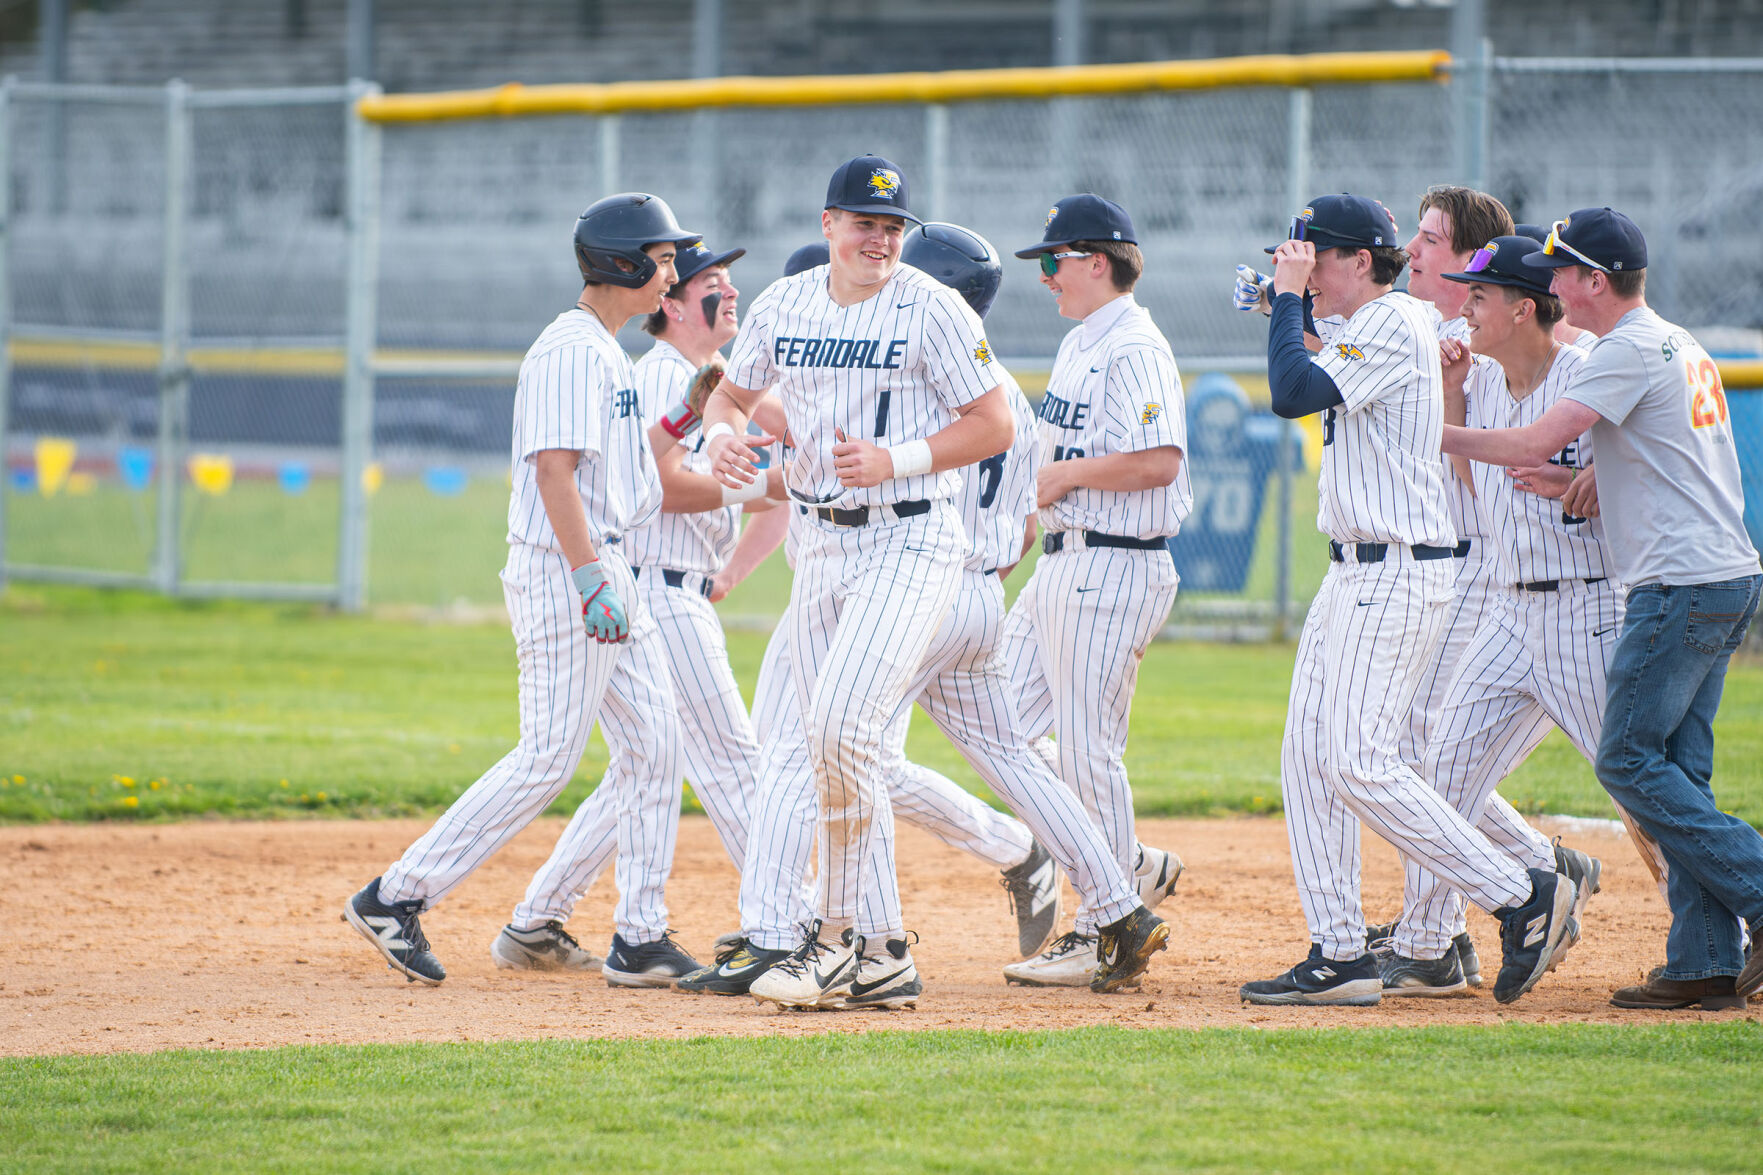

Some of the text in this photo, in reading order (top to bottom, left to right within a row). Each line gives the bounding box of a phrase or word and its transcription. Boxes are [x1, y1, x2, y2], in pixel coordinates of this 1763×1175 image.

[774, 336, 908, 369] FERNDALE
[873, 390, 892, 438] 1
[1685, 358, 1727, 429] 23
